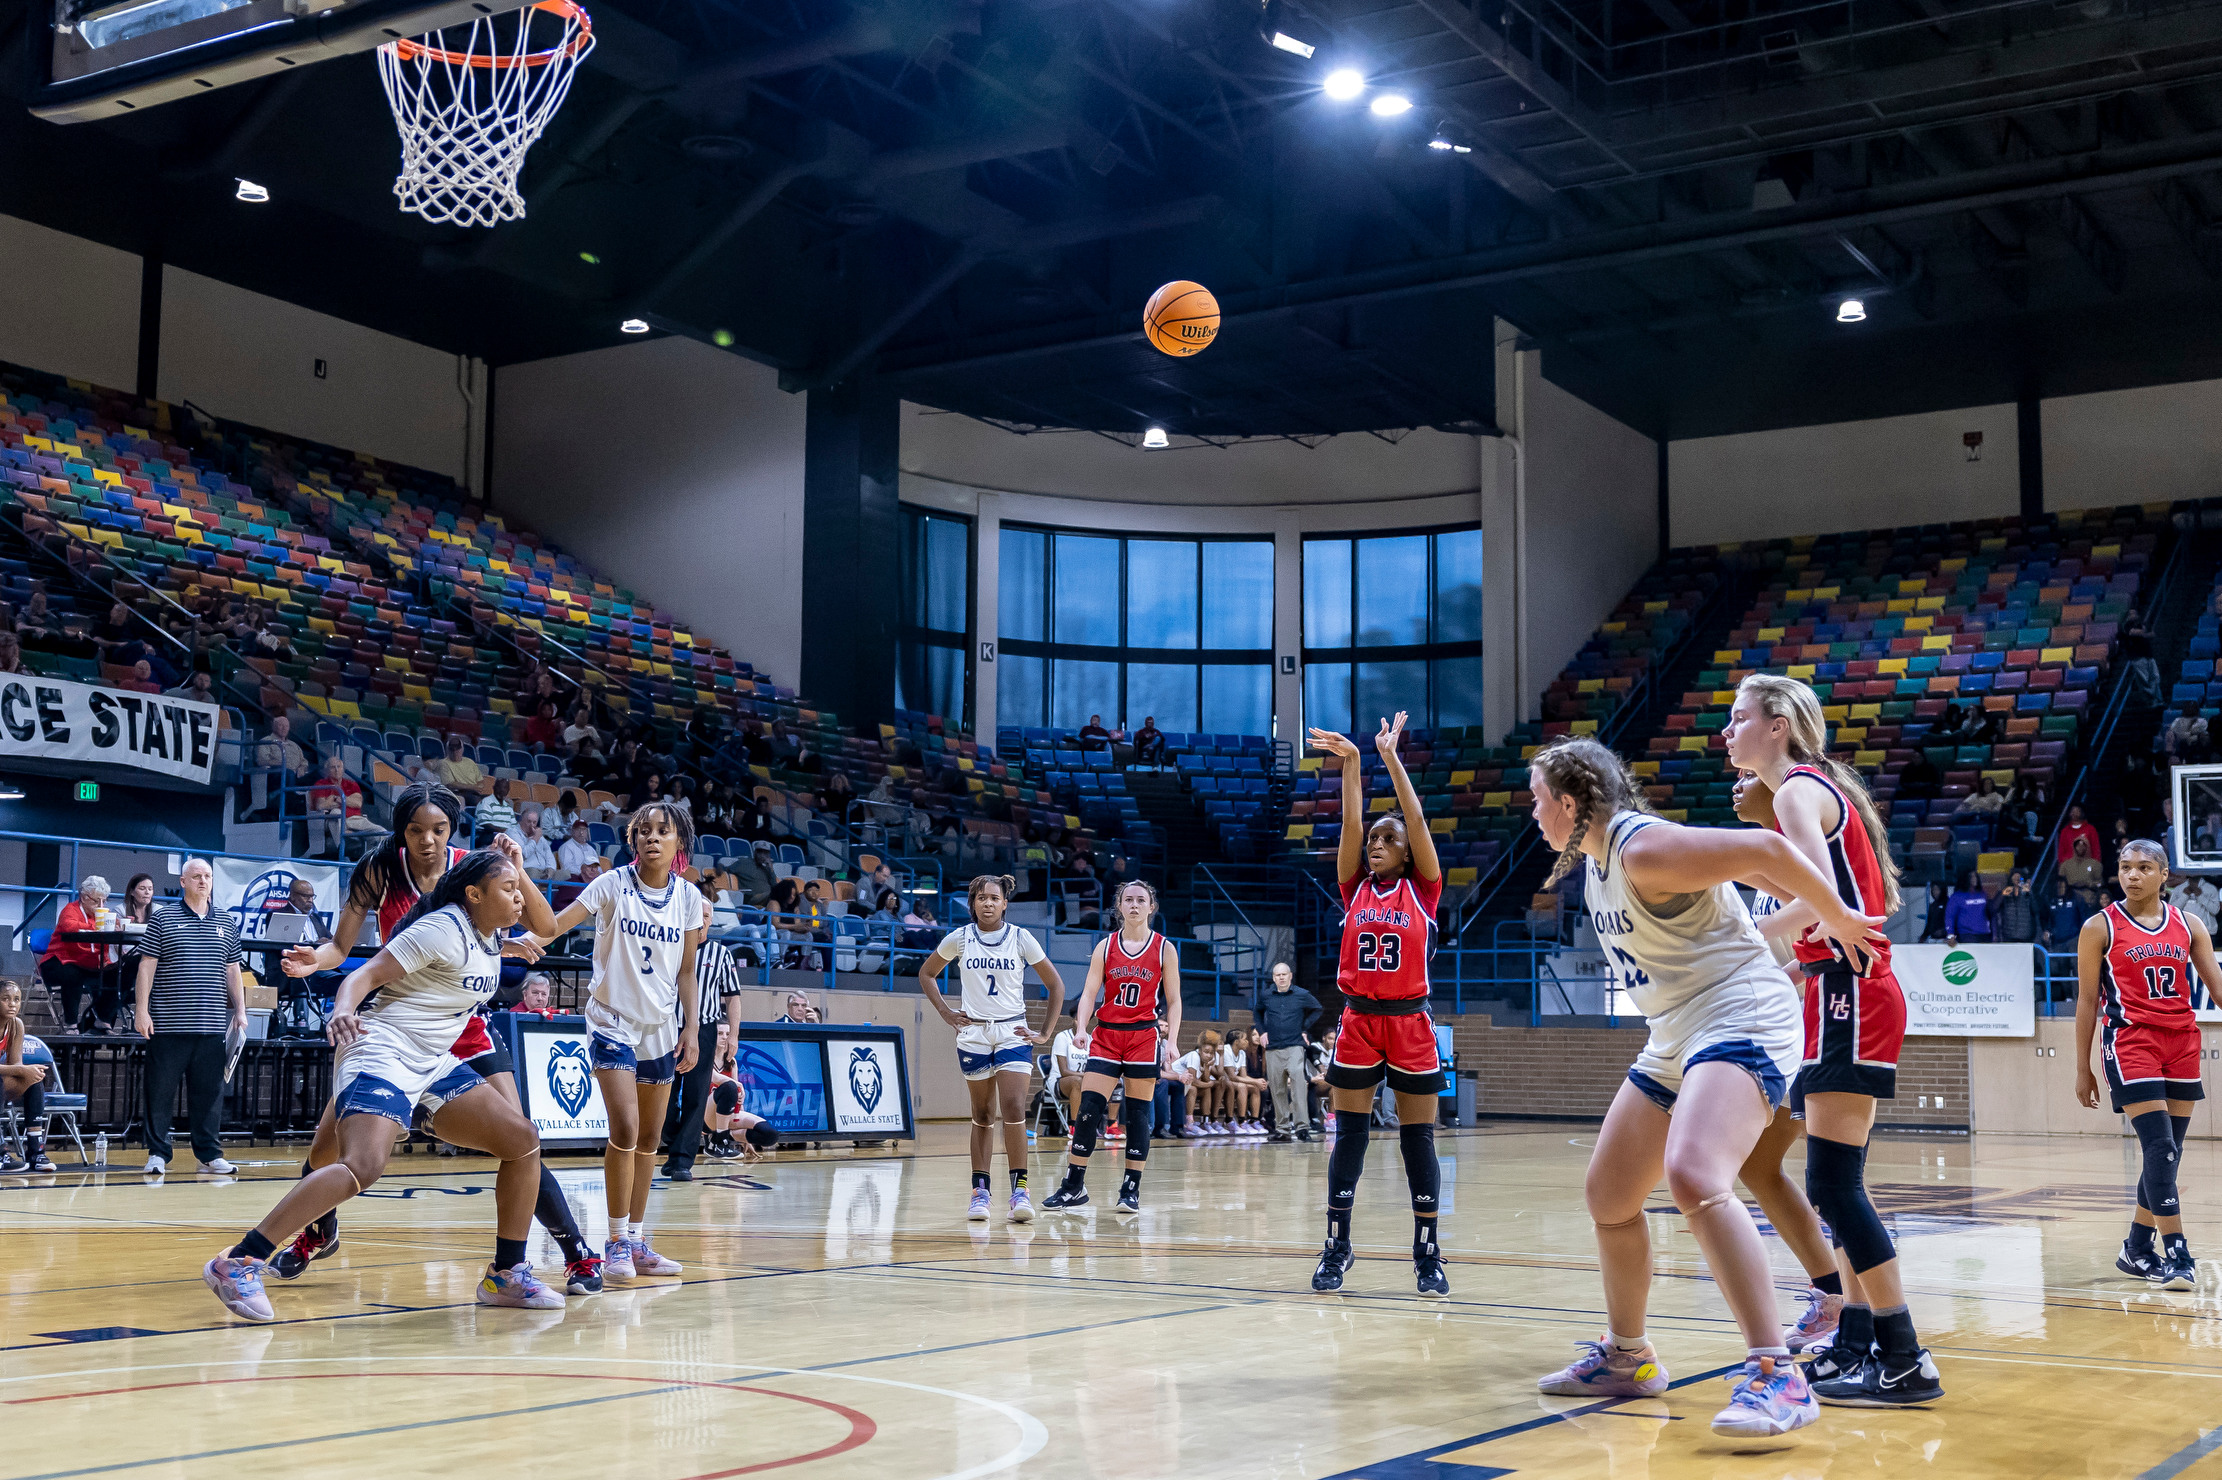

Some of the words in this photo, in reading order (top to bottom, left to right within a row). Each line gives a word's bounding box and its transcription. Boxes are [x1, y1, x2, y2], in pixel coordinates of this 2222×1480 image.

[1181, 325, 1219, 338] Wilso
[317, 361, 325, 376] J
[983, 644, 993, 660] K
[1283, 657, 1293, 672] L
[0, 682, 71, 744] CE
[88, 691, 213, 769] STATE
[80, 782, 98, 800] EXIT
[1355, 906, 1411, 928] TROJANS
[620, 917, 680, 944] COUGARS
[641, 946, 654, 975] 3
[1358, 932, 1401, 972] 23
[2125, 942, 2187, 964] TROJANS
[966, 957, 1016, 971] COUGARS
[1109, 965, 1155, 982] TROJANS
[986, 974, 999, 996] 2
[2143, 966, 2181, 1000] 12
[1113, 982, 1141, 1008] 10
[1909, 991, 1962, 1002] Cullman
[1966, 991, 2015, 1003] Electric
[1922, 1003, 1999, 1016] Cooperative
[533, 1119, 582, 1132] WALLACE
[585, 1119, 609, 1131] STAT
[840, 1115, 876, 1126] WALLACE
[878, 1114, 901, 1126] STATE
